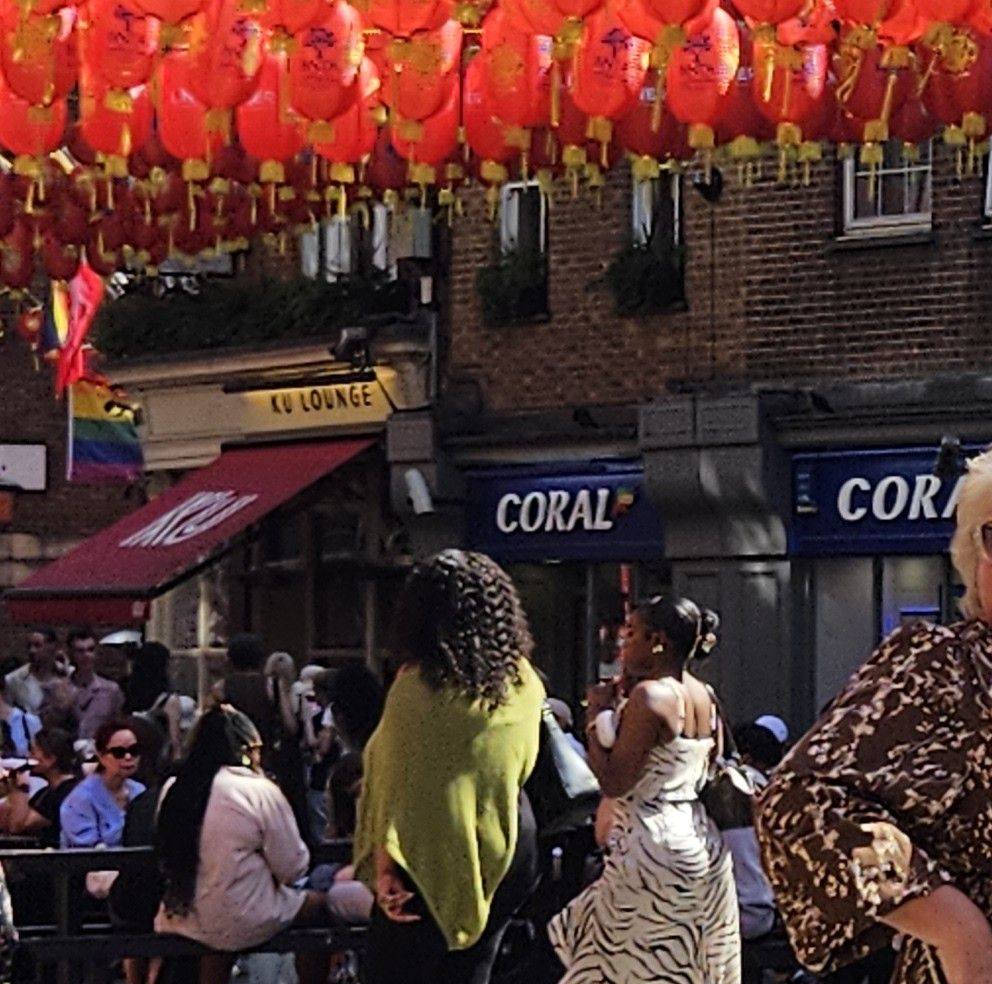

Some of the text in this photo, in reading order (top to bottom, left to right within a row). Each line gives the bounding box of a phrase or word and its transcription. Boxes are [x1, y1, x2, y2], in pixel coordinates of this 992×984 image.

[270, 384, 373, 416] KU LOUNGE
[496, 487, 615, 534] CORAL
